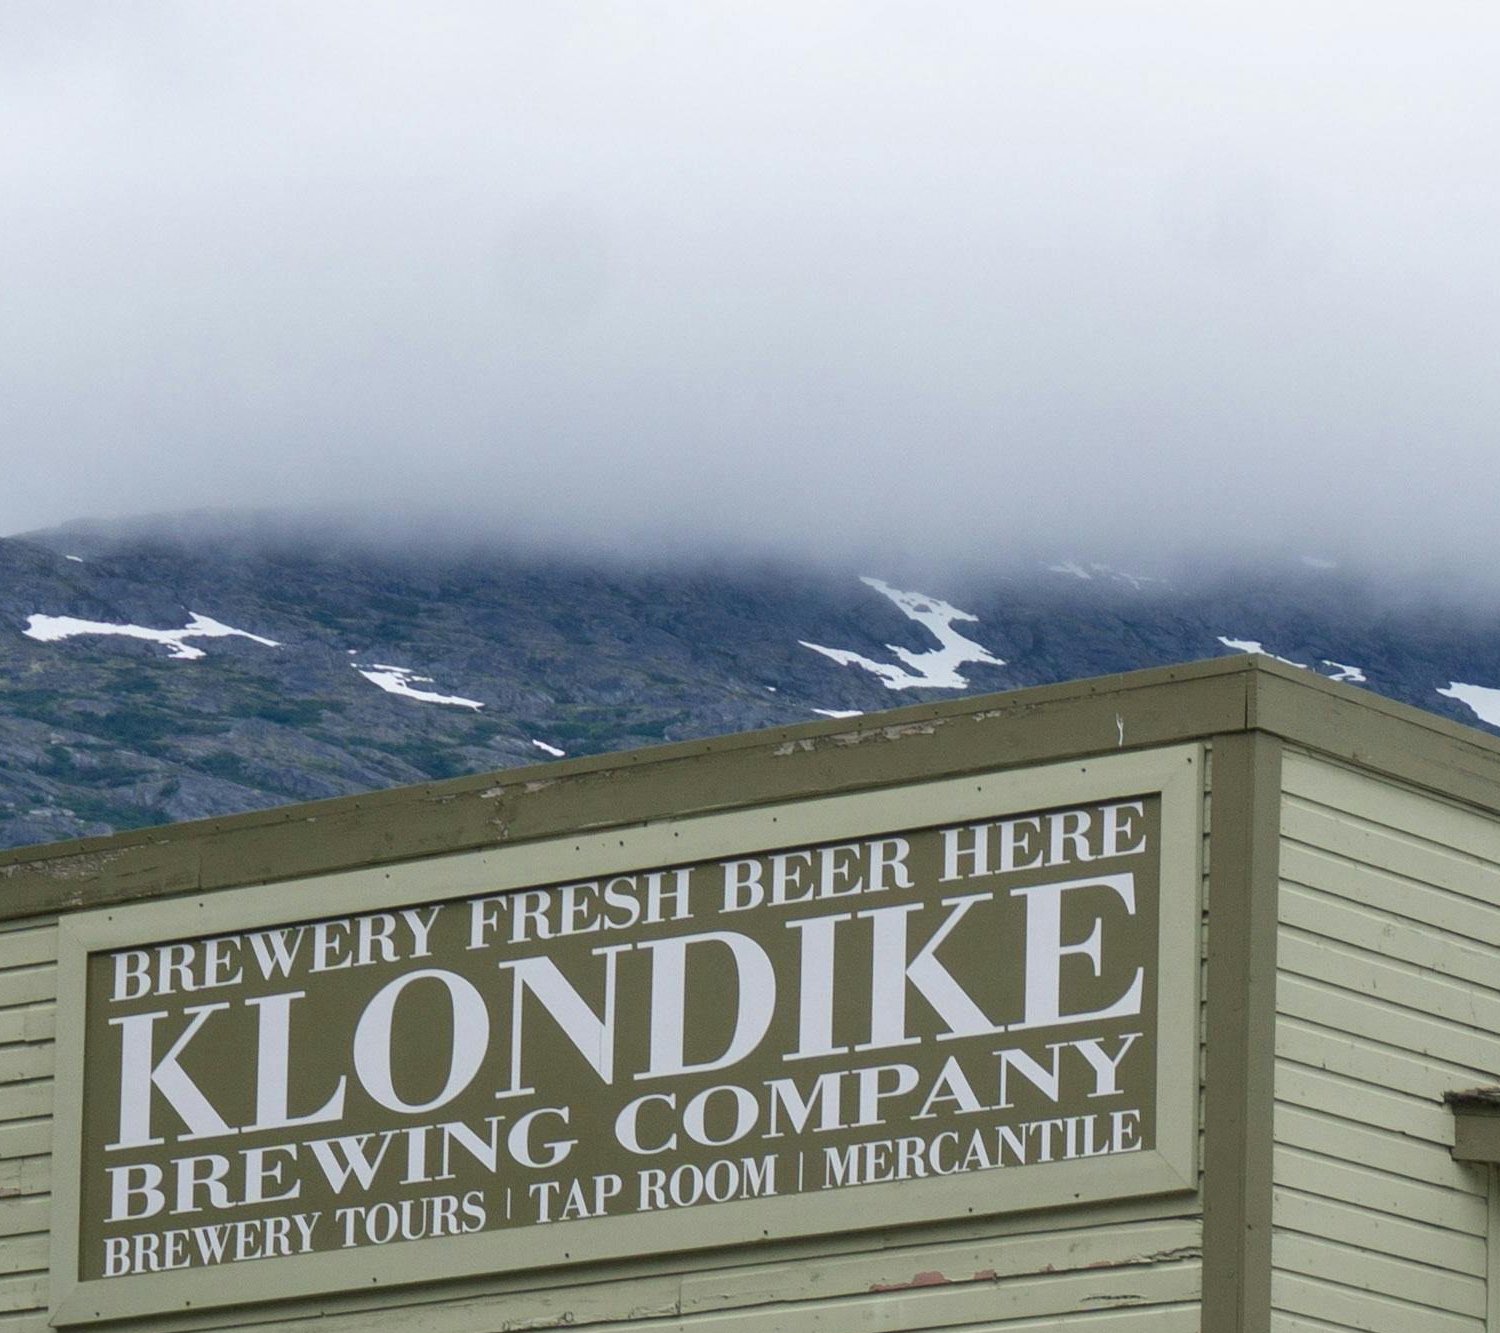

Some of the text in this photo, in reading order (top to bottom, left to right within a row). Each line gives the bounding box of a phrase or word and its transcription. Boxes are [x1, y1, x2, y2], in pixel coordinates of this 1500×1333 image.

[110, 801, 1146, 1002] BREWERY FRESH BEER HERE
[105, 872, 1145, 1151] KLONDIKE
[102, 1109, 1143, 1278] BREWERY TOURS TAP ROOM MERCANTILE
[104, 1033, 1144, 1223] BREWING COMPANY
